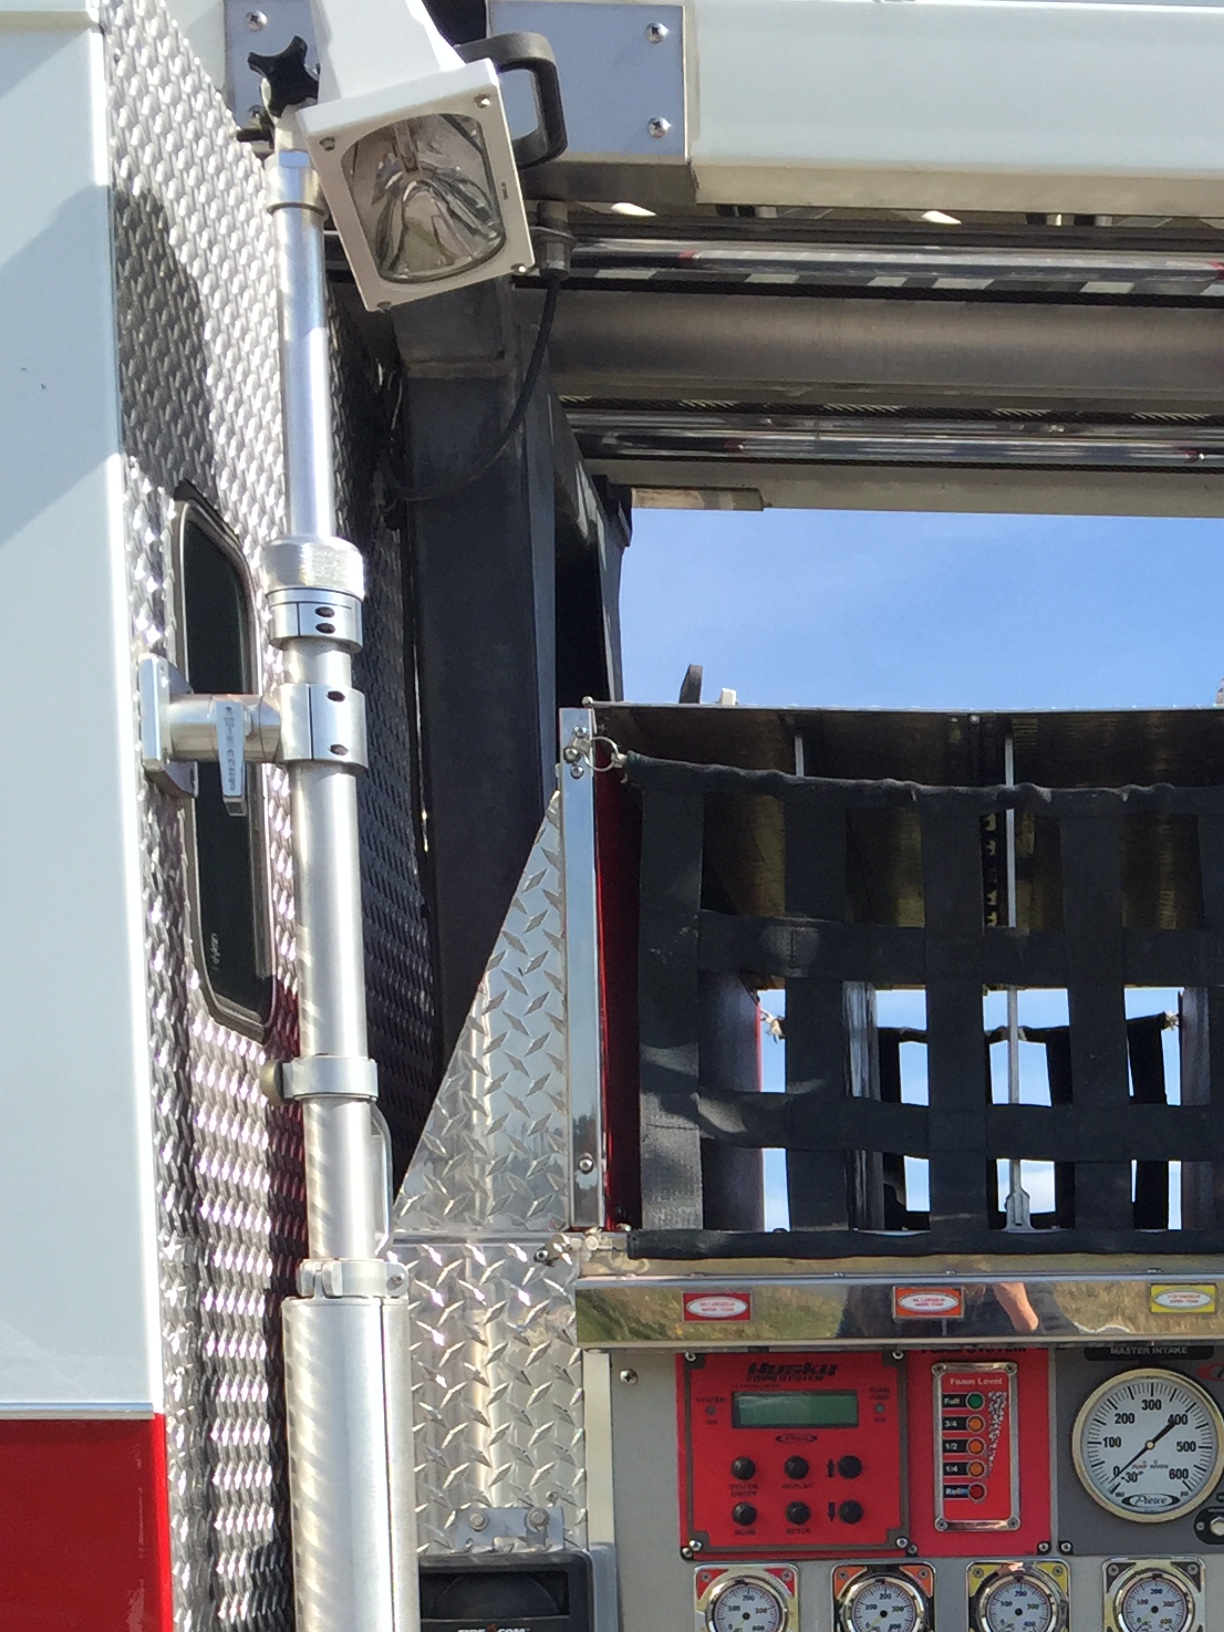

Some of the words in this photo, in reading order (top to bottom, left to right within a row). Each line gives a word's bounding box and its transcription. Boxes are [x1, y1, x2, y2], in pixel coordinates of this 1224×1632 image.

[1110, 1347, 1149, 1355] MASTER
[1150, 1346, 1188, 1354] INTAKE
[747, 1362, 838, 1376] Husky
[950, 1378, 976, 1386] Foam
[978, 1377, 1002, 1385] Level
[1141, 1399, 1161, 1410] 300
[1115, 1413, 1135, 1424] 200
[1168, 1414, 1188, 1425] 400
[1103, 1436, 1121, 1448] 100
[1176, 1441, 1196, 1452] 500
[1169, 1468, 1189, 1479] 600
[1134, 1495, 1167, 1506] Pierce
